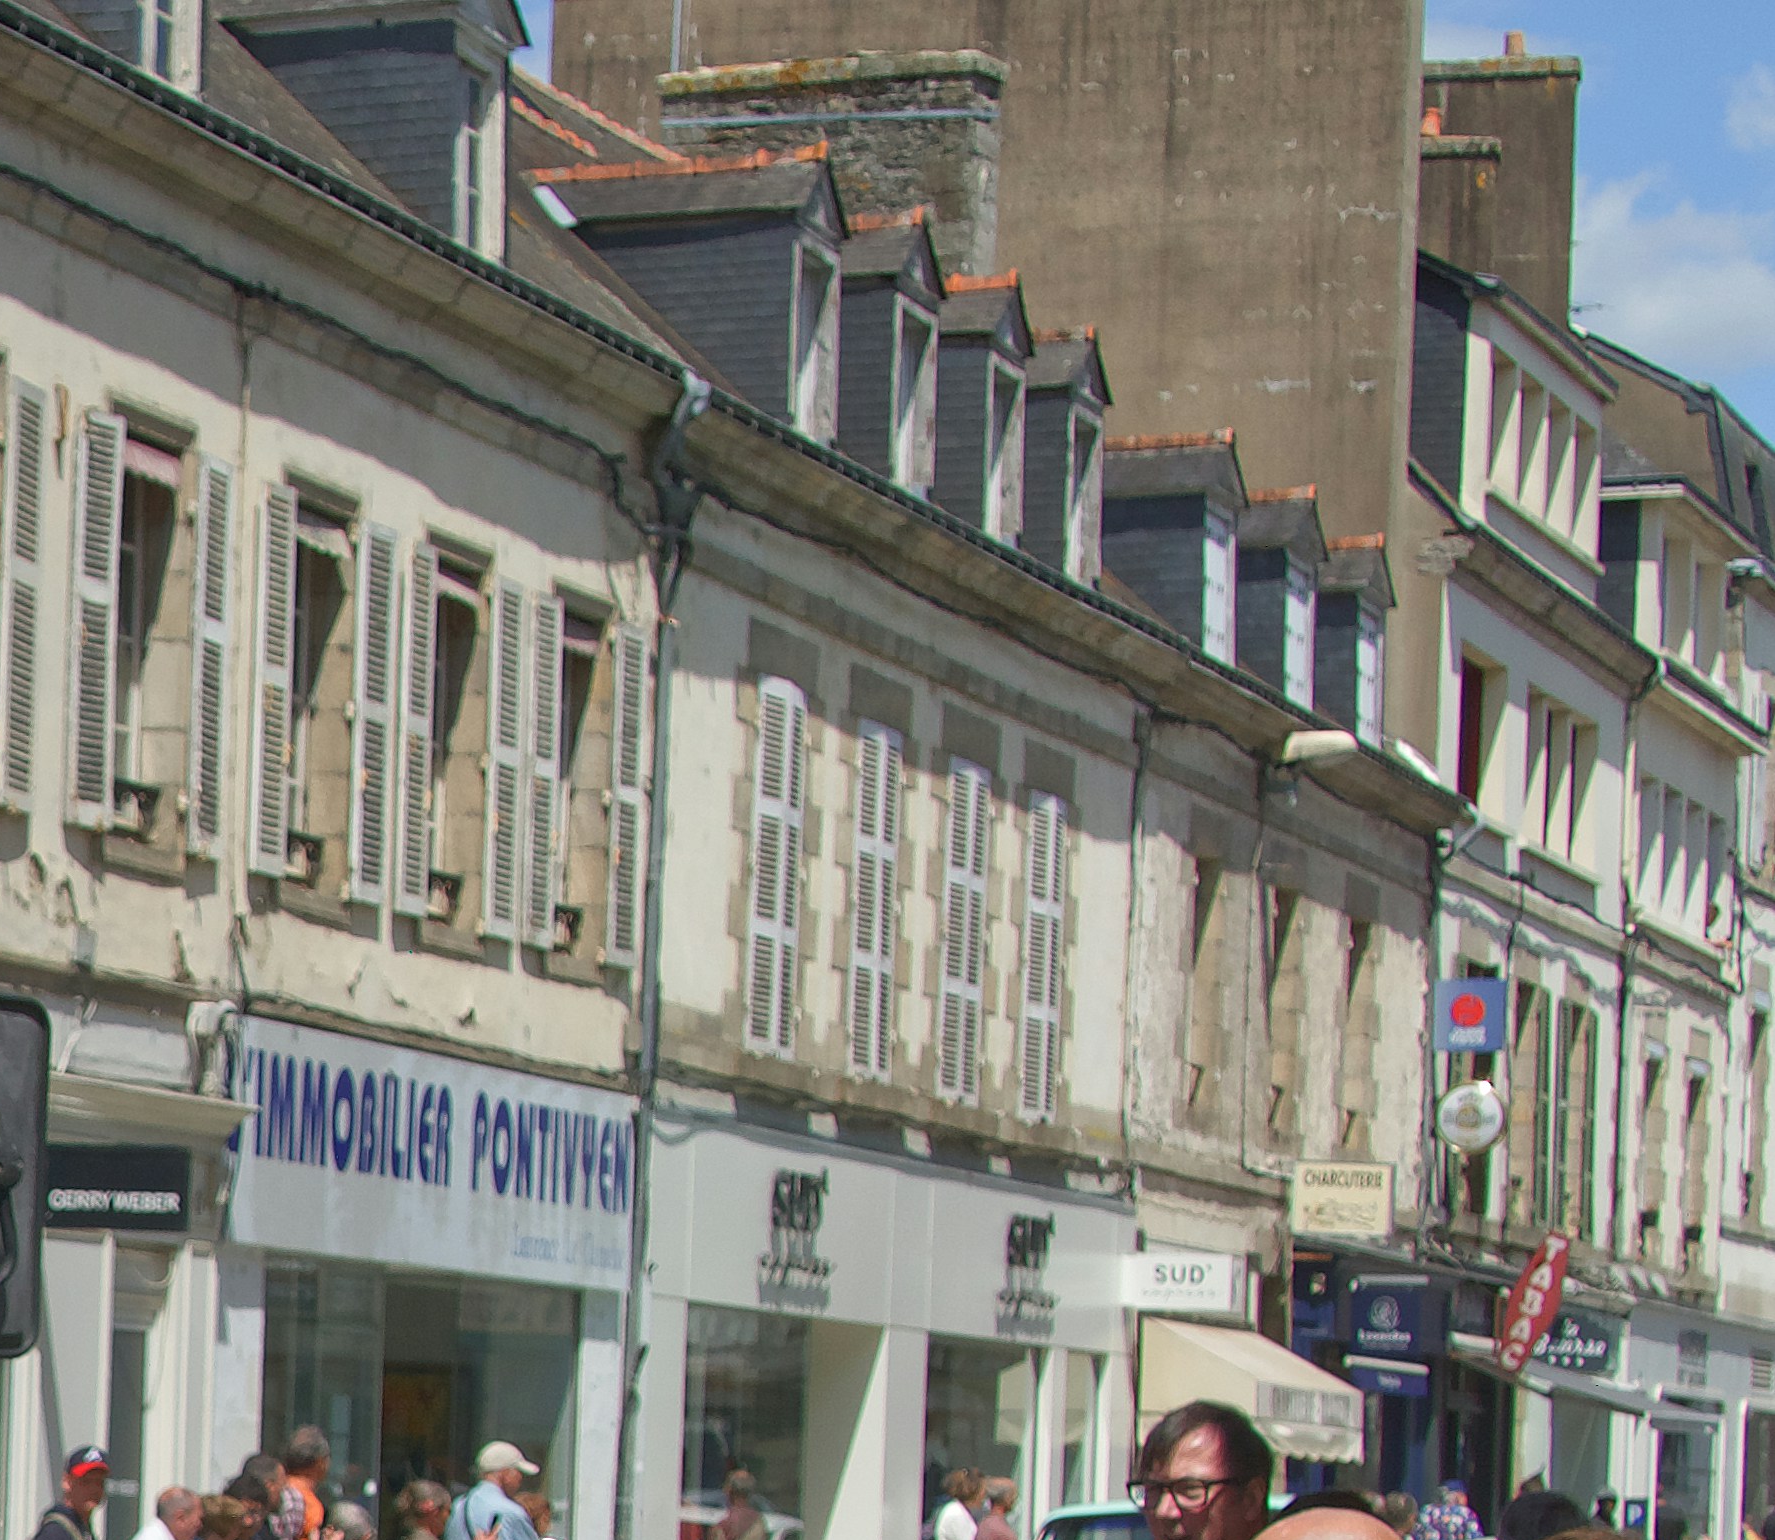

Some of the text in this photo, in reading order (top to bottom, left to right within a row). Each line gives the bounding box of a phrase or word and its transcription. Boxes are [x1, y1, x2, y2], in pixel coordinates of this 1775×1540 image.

[228, 1046, 632, 1214] 'IMMOBILIER PONTIVYEN
[1501, 1235, 1568, 1371] TABAC
